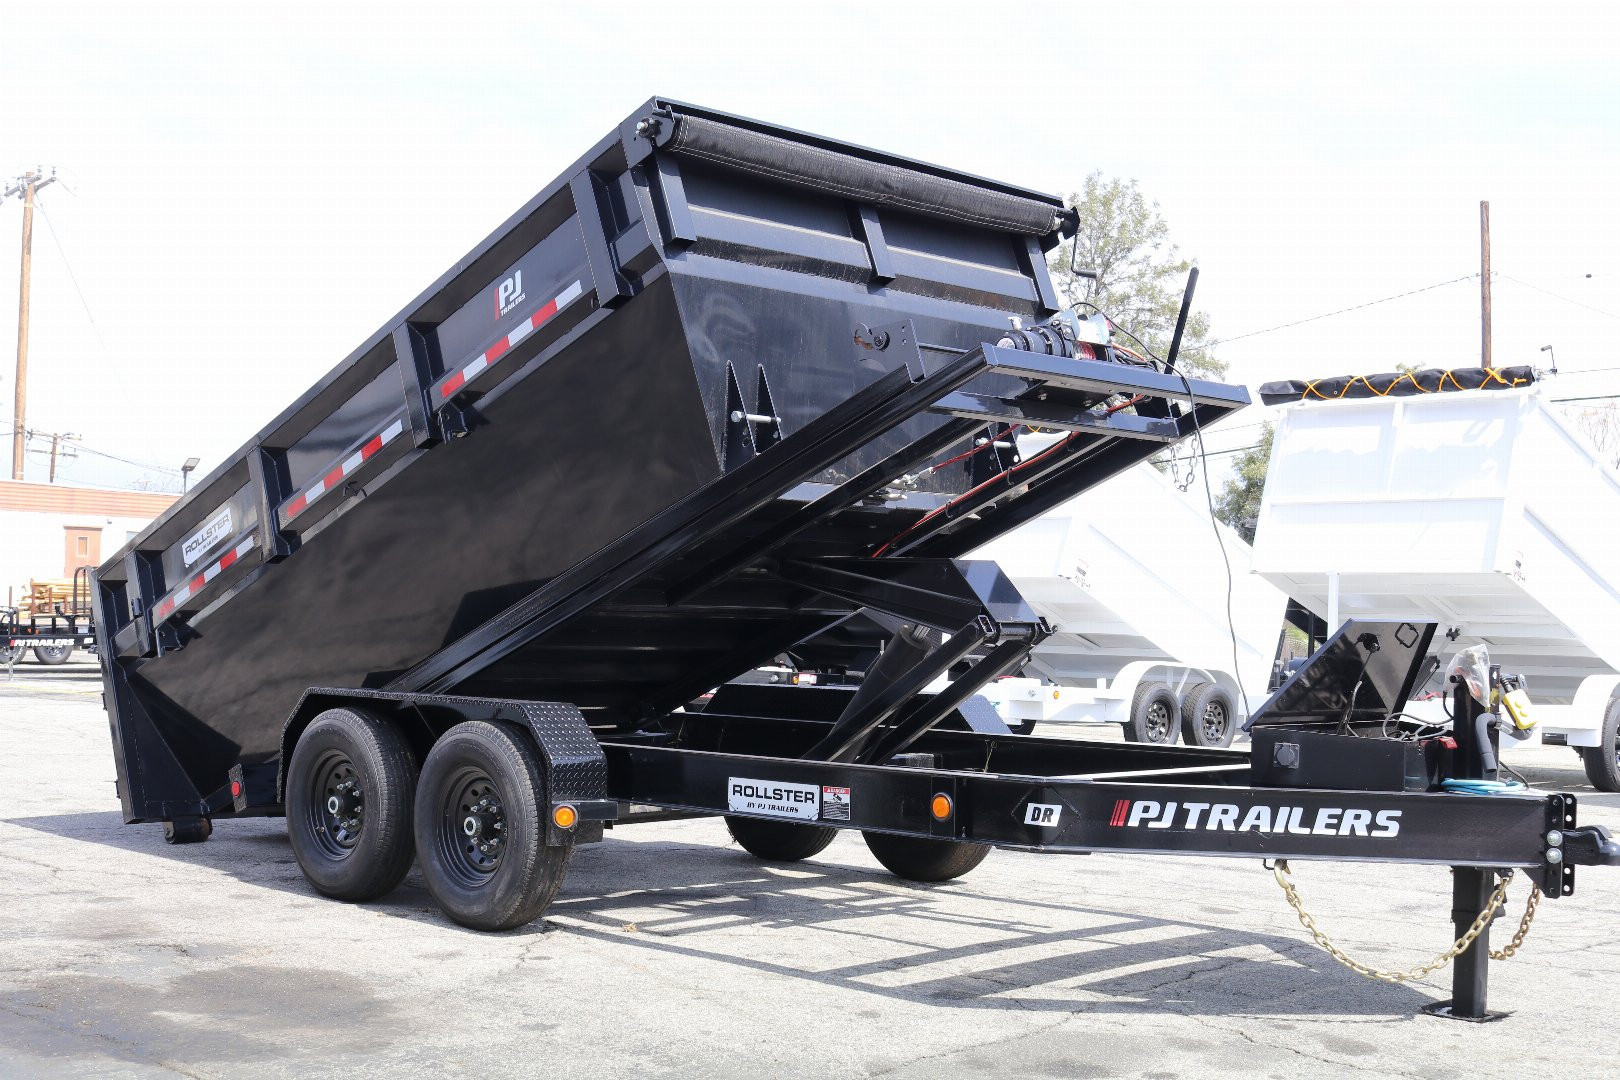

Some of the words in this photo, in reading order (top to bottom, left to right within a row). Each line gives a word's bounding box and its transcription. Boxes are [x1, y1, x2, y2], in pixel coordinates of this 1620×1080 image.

[499, 269, 521, 310] PJ
[501, 292, 526, 317] TRAILERS
[185, 513, 230, 556] ROLLSTER
[26, 638, 75, 647] TRAILERS
[732, 784, 815, 803] ROLLSTER
[746, 801, 756, 809] BY
[768, 804, 799, 813] TRAILERS
[1030, 806, 1053, 823] DR
[1183, 802, 1403, 838] TRAILERS
